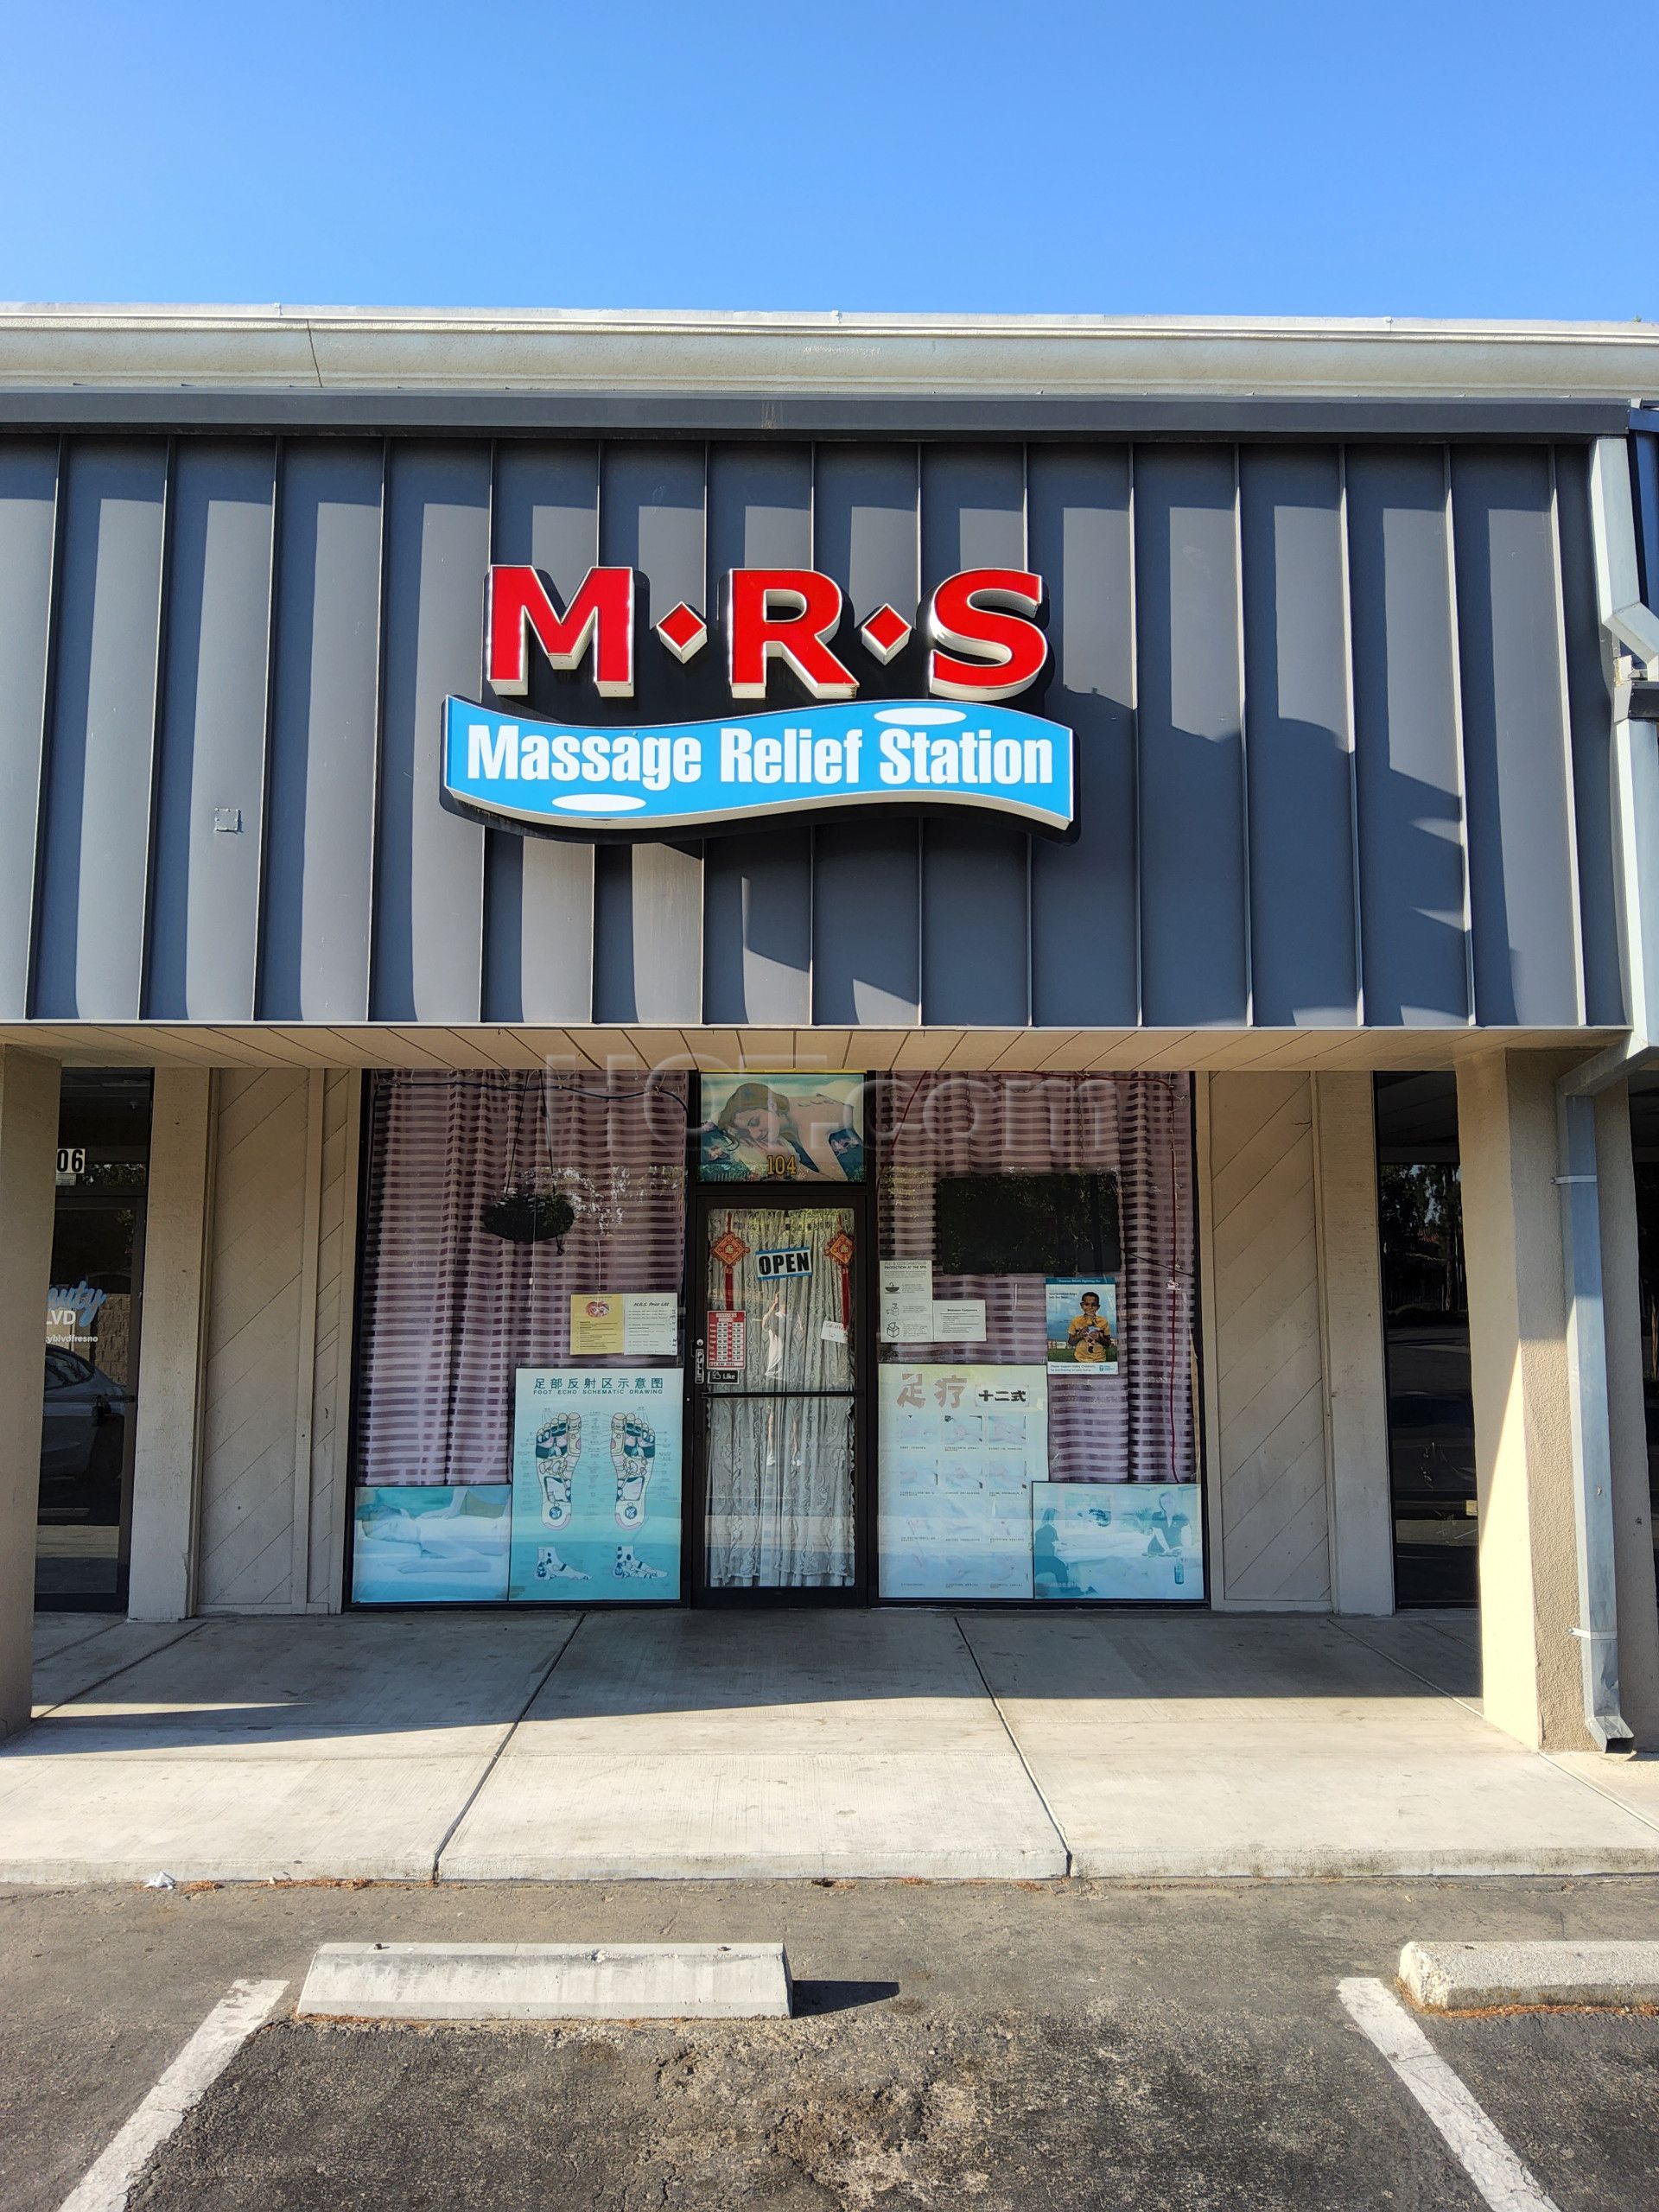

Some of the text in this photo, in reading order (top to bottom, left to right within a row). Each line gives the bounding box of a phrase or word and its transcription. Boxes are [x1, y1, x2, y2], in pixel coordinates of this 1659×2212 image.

[467, 724, 1053, 791] Massage Relief Station
[767, 1155, 797, 1175] 104
[759, 1252, 810, 1275] OPEN
[533, 1377, 664, 1389] 足部反射区示意图
[978, 1389, 1027, 1402] 十二式
